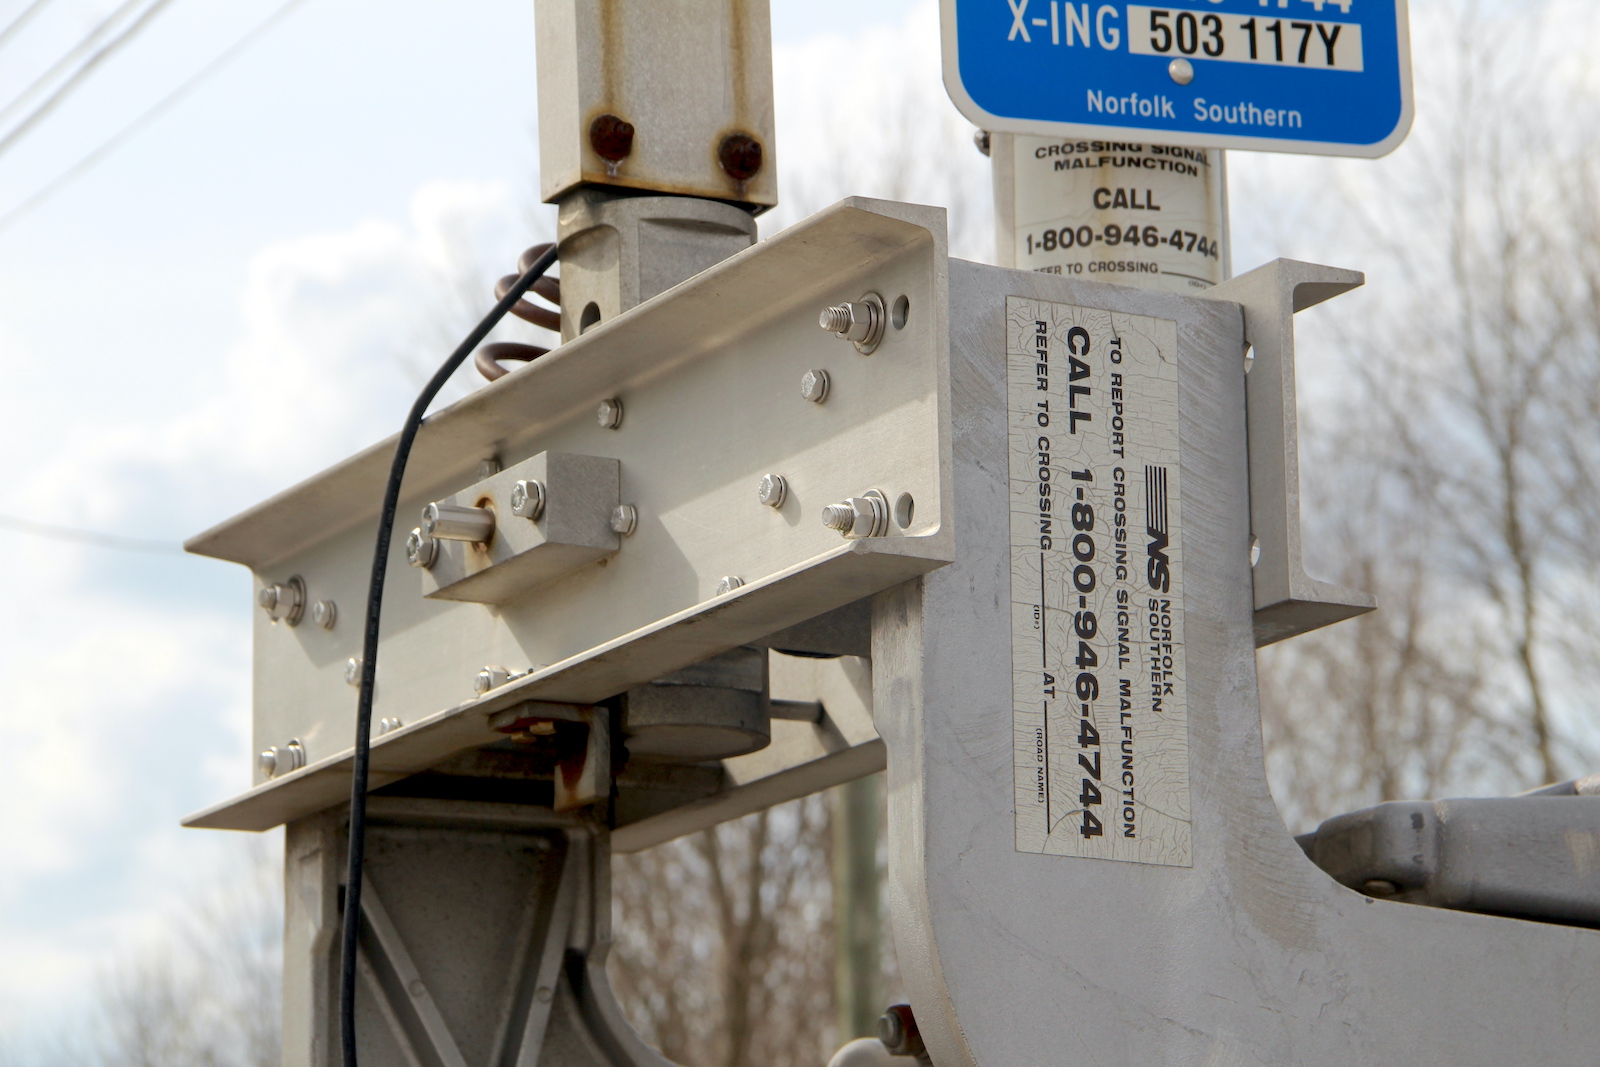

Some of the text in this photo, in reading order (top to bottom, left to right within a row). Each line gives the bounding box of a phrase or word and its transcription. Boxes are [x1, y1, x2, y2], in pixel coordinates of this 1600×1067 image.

[1007, 0, 1342, 66] X-ING 503 117Y
[1087, 89, 1303, 128] Norfolk Southern
[1054, 156, 1199, 177] MALFUNCTION
[1093, 187, 1161, 211] CALL
[1026, 224, 1219, 262] 1-800-946-4744
[1066, 262, 1083, 274] TO
[1088, 261, 1159, 273] CROSSING
[1035, 320, 1056, 699] REFER TO CROSSING AT
[1067, 326, 1103, 840] CALL 1-800-946-4744
[1110, 337, 1136, 839] TO REPORT CROSSING SIGNAL MALFUNCTION
[1148, 598, 1163, 713] SOUTHERN
[1159, 599, 1174, 696] NORFOLK
[1037, 767, 1045, 803] NAME)
